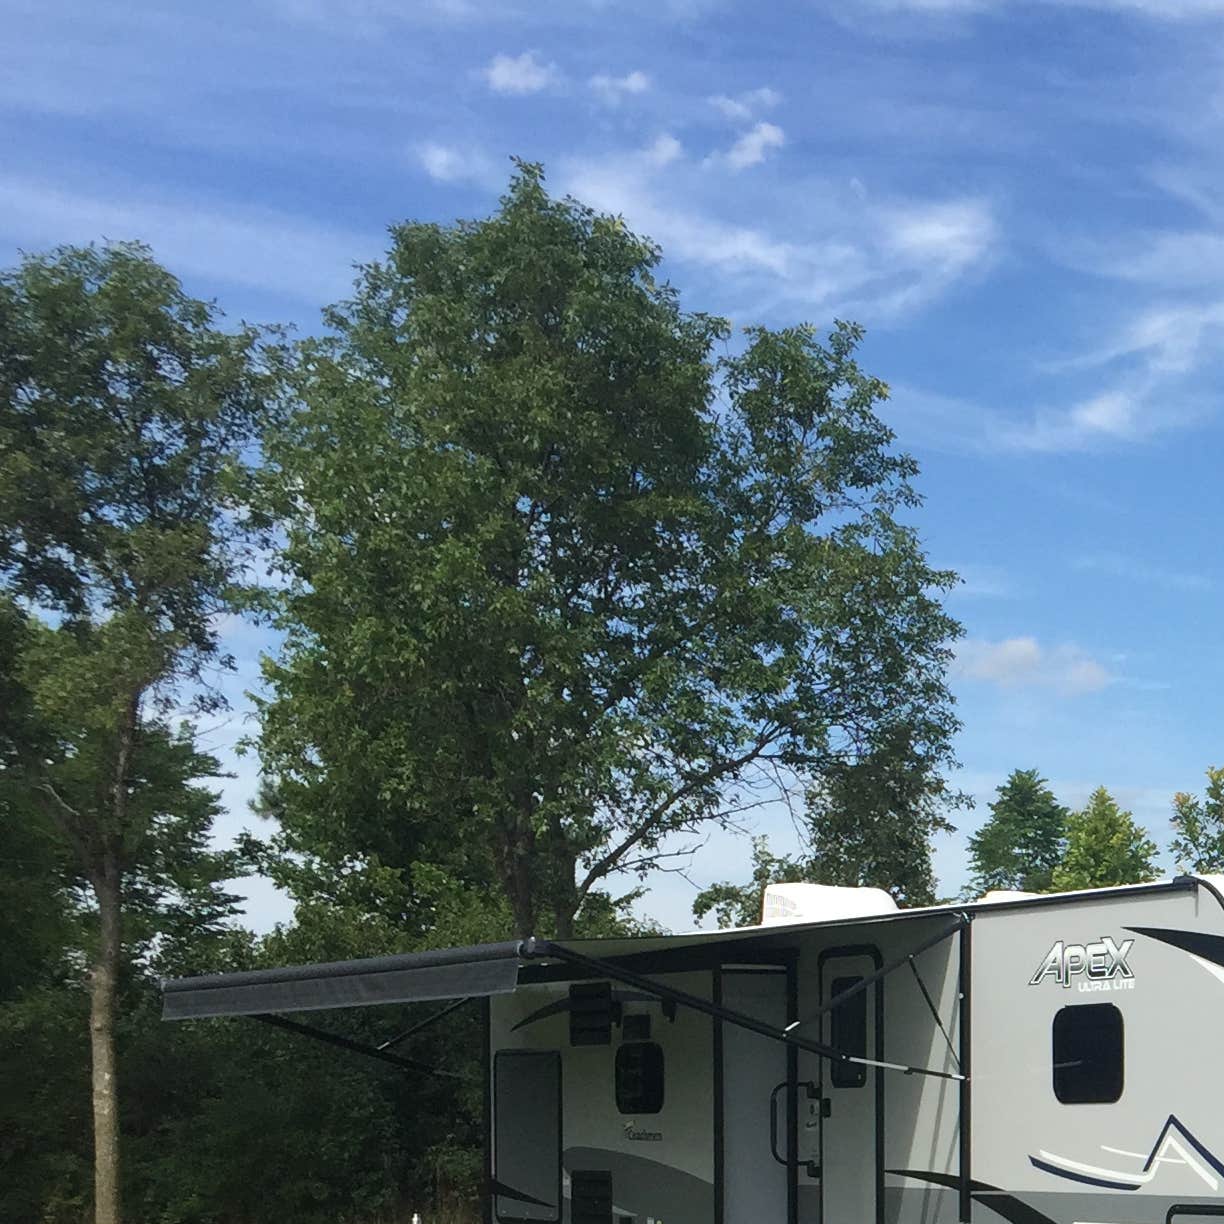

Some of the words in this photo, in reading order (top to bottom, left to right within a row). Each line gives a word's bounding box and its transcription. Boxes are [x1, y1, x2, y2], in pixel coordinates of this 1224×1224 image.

[1028, 936, 1135, 988] APEX
[1077, 981, 1112, 992] ULTRA
[1113, 978, 1136, 991] LITE
